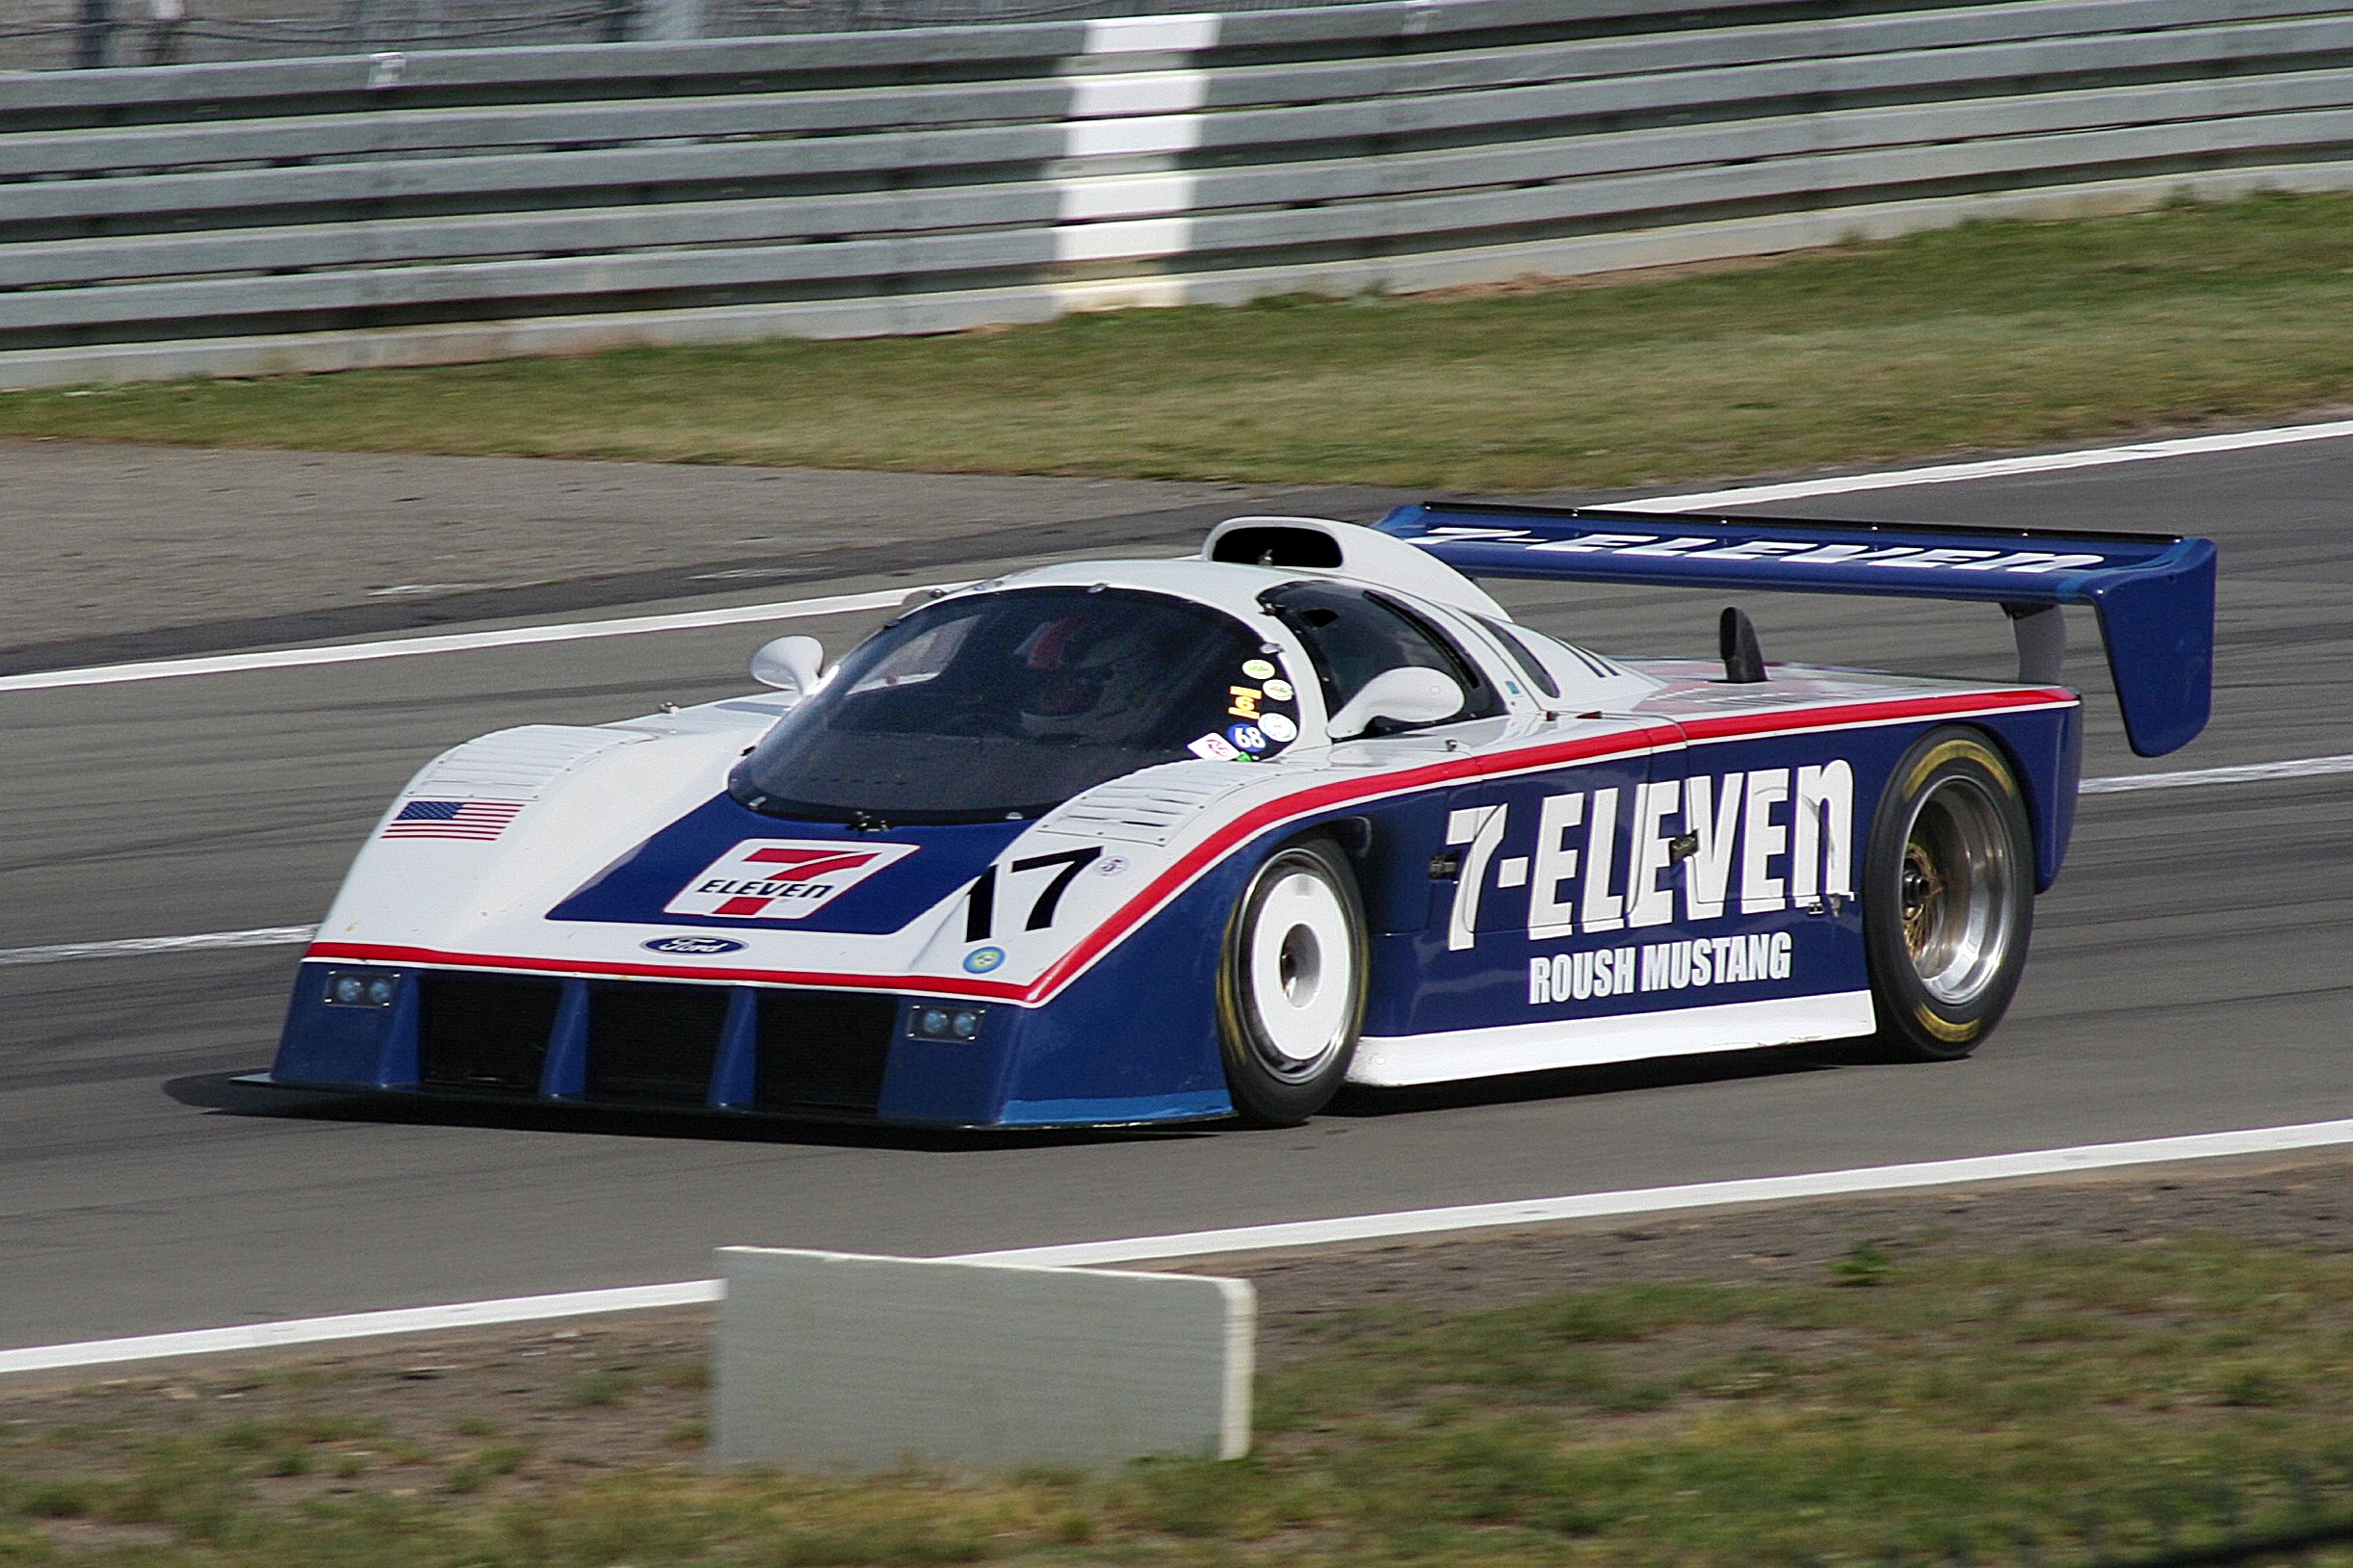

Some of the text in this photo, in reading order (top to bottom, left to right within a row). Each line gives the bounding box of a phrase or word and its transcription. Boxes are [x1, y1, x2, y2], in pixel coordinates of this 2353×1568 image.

[1235, 727, 1267, 748] 68
[965, 845, 1104, 943] 17
[659, 938, 729, 953] Ford
[1529, 931, 1792, 1006] ROUSH MUSTANG
